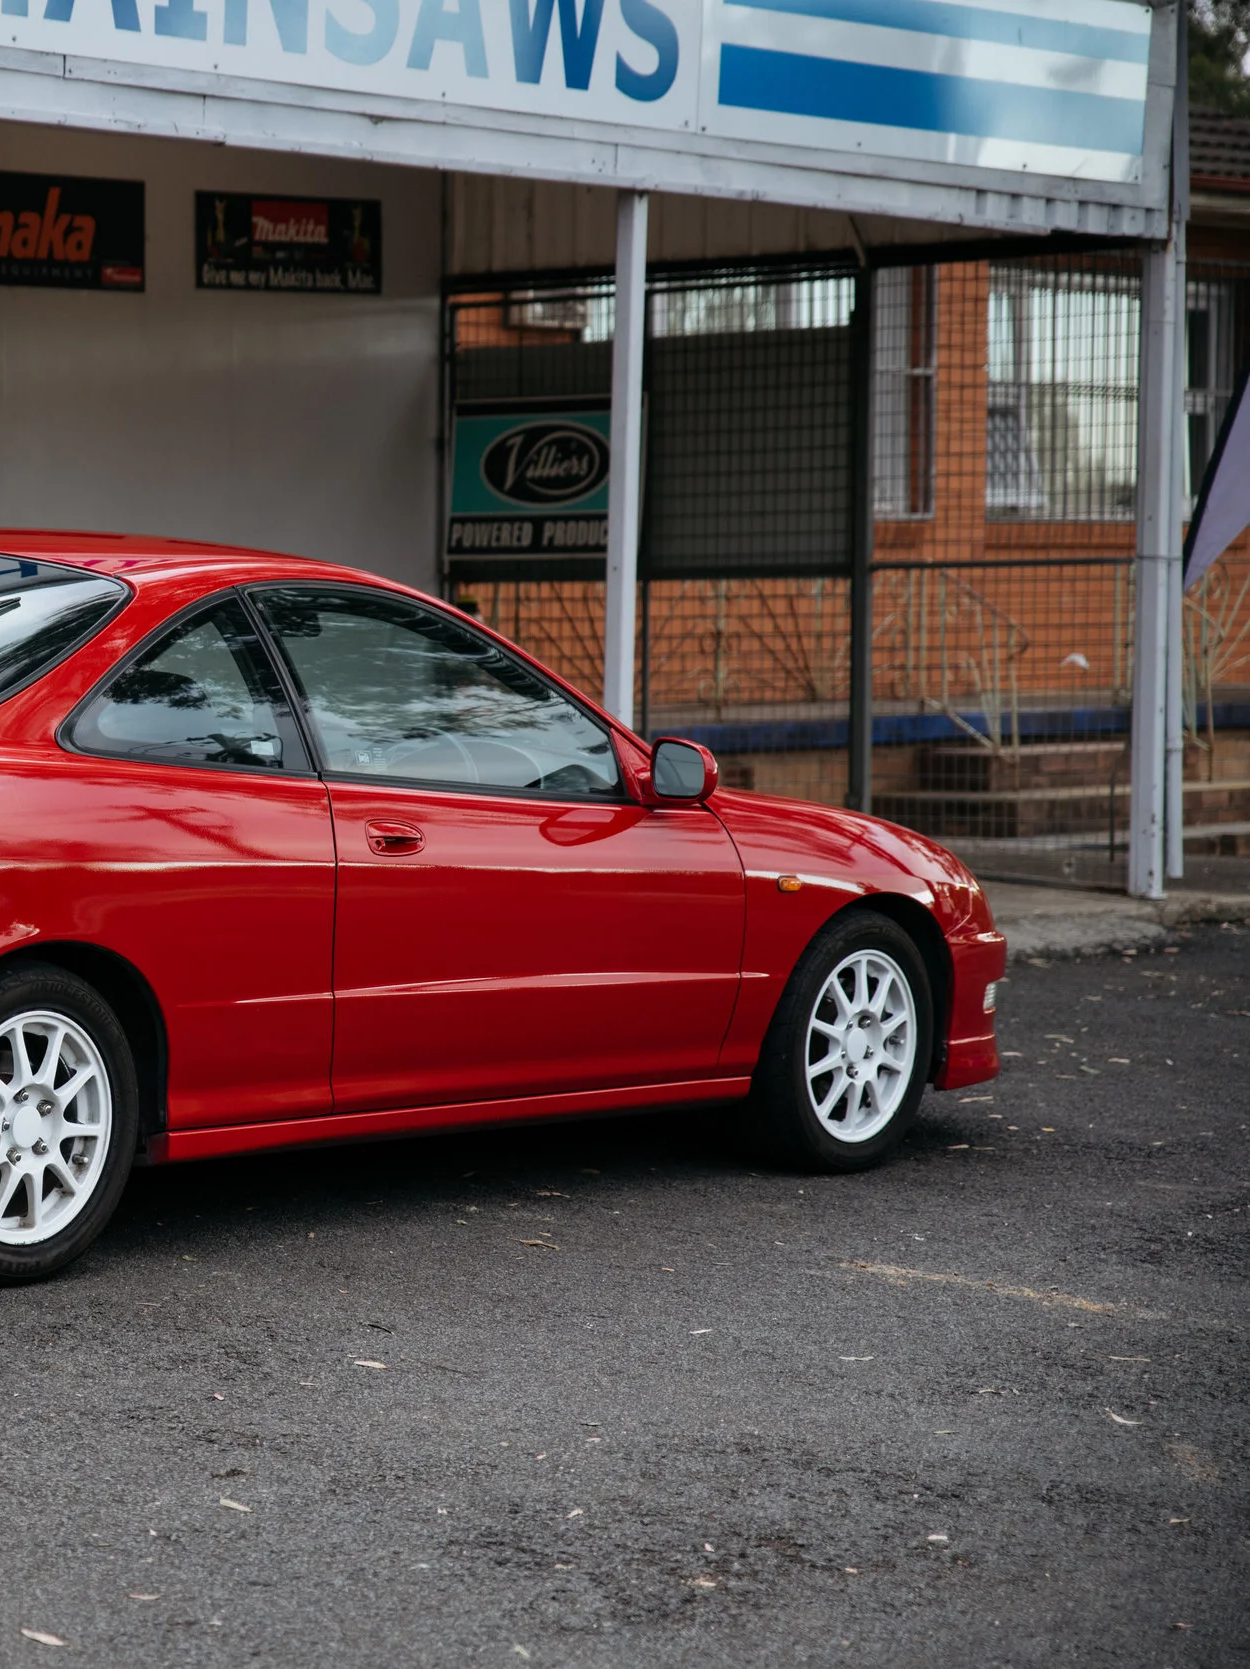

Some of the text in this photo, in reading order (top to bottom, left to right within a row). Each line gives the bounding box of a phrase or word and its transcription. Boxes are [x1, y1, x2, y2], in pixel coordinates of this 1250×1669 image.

[1, 263, 95, 280] EQUIPMENT
[202, 263, 227, 286] Give
[268, 264, 313, 288] Makita
[504, 430, 596, 494] Villiers
[451, 519, 609, 548] POWERED PRODUC
